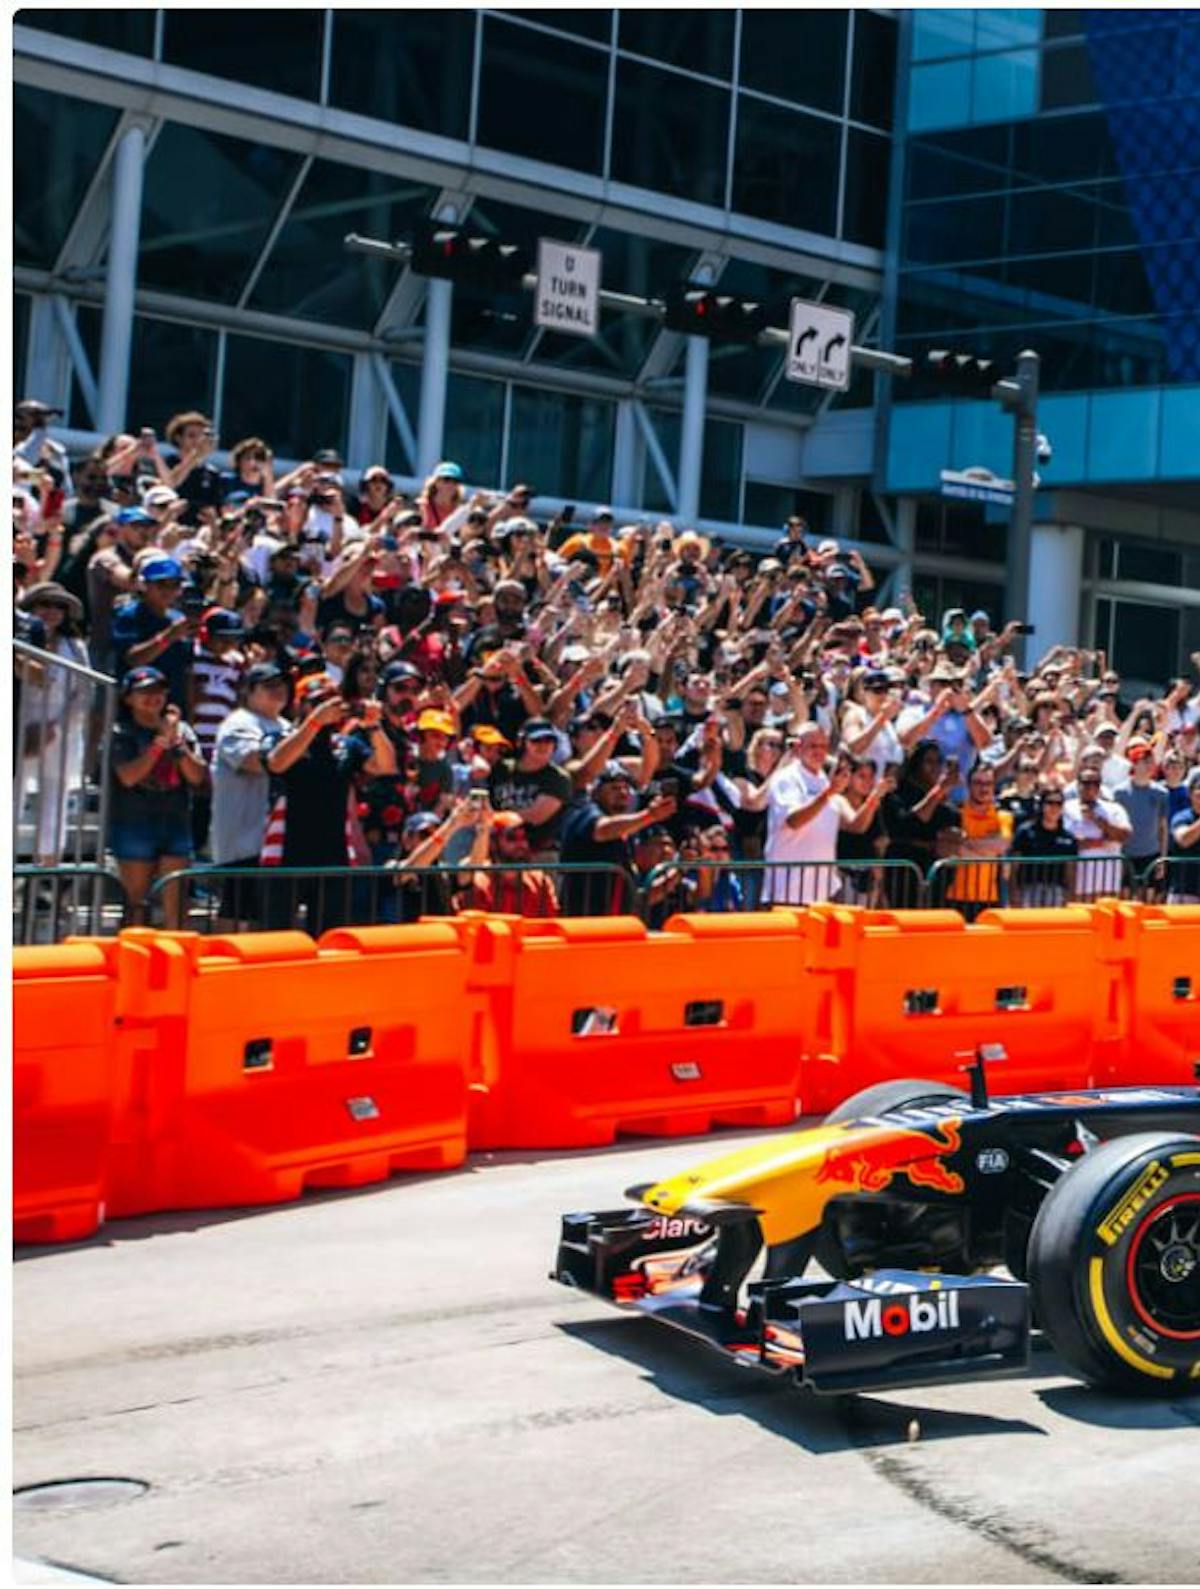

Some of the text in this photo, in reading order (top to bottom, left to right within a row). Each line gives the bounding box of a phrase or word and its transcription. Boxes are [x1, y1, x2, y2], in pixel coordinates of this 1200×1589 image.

[551, 276, 587, 299] TURN
[541, 299, 591, 326] SIGNAL
[791, 360, 816, 375] ONLY
[641, 1216, 710, 1240] Claro
[844, 1289, 960, 1341] Mobil
